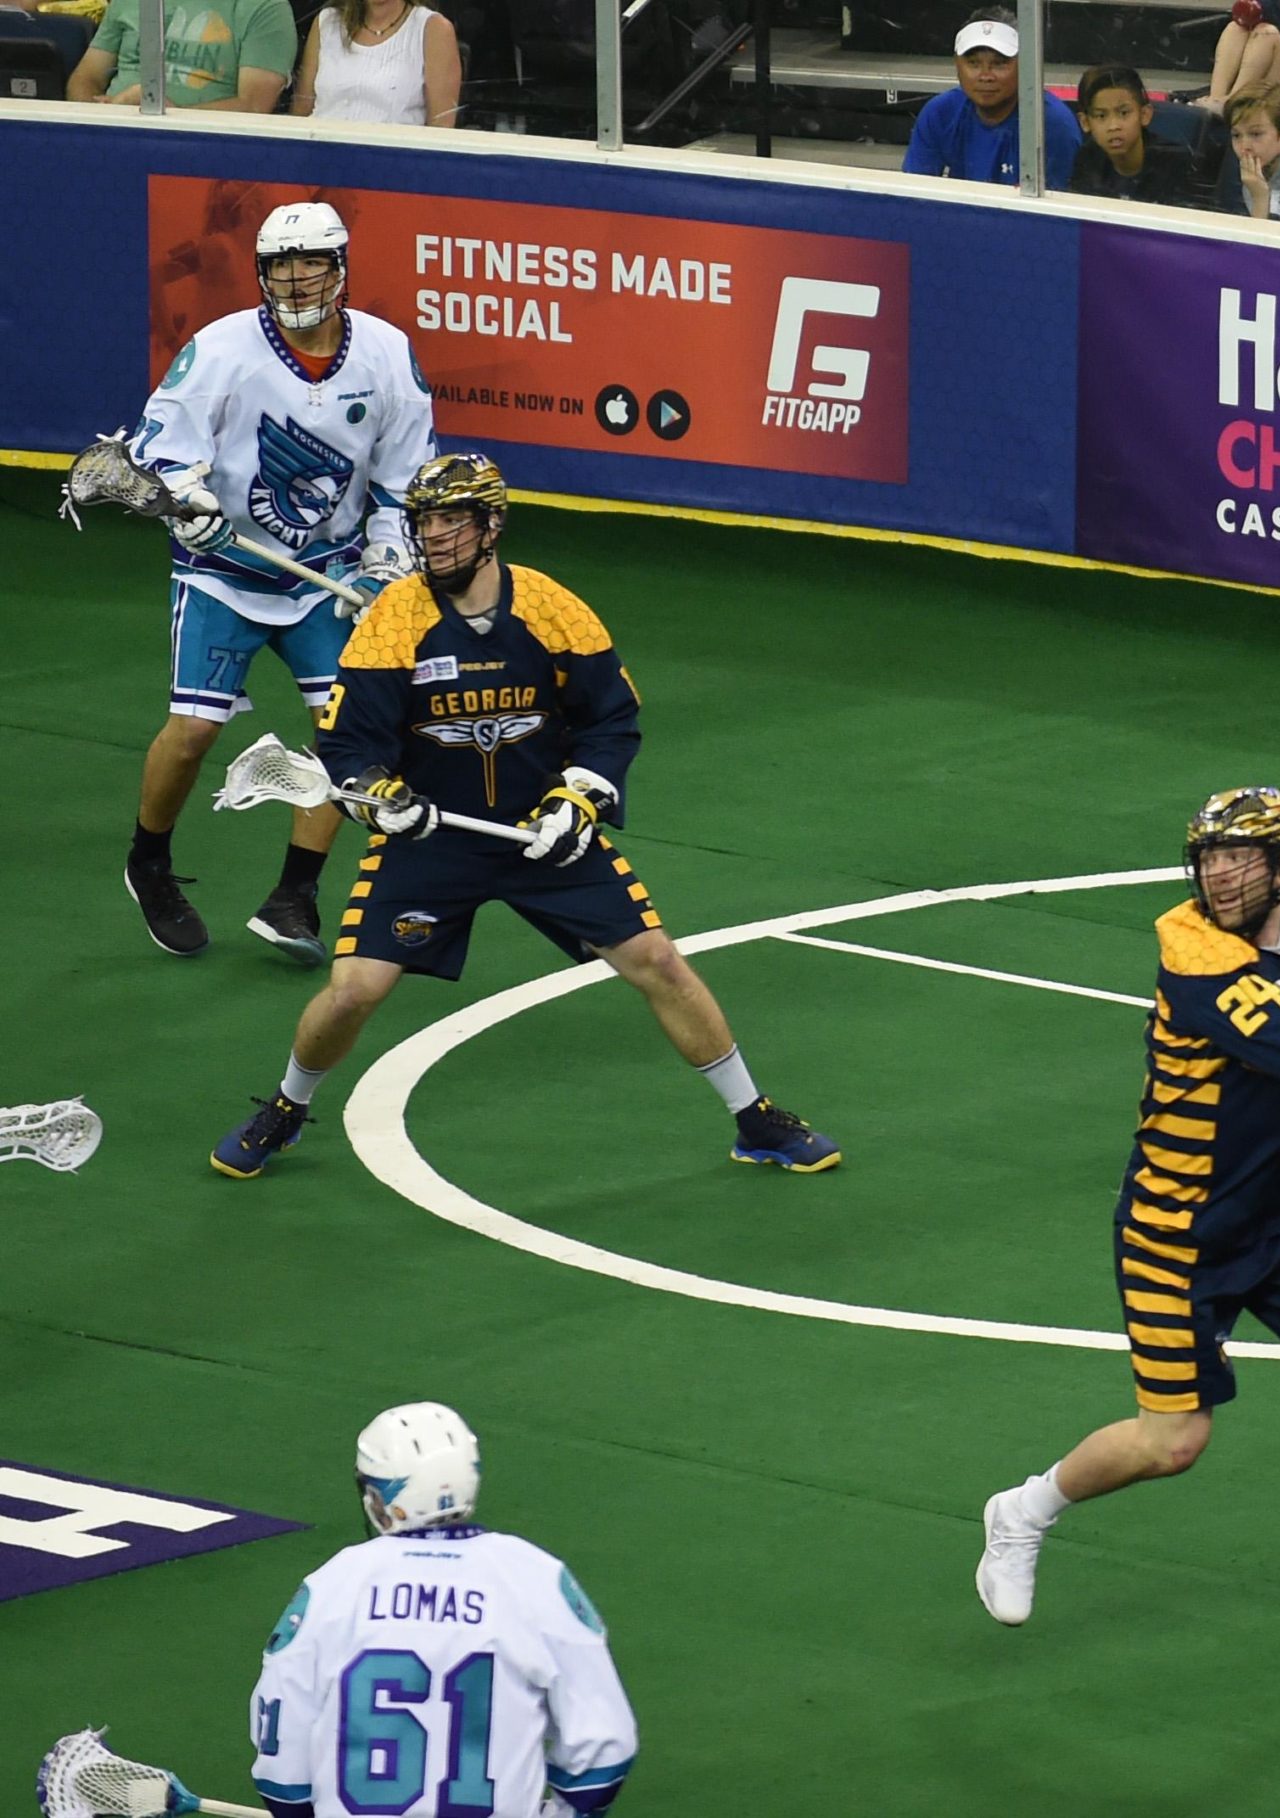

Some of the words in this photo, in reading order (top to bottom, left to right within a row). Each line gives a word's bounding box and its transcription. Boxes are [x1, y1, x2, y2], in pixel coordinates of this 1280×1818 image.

[165, 40, 222, 73] BLIN
[415, 234, 597, 290] FITNESS
[611, 252, 732, 304] MADE
[415, 289, 573, 343] SOCIAL
[513, 393, 555, 414] NOW
[559, 396, 584, 416] ON
[761, 396, 862, 434] FITGAPP
[293, 427, 346, 468] ROCHESTER
[430, 686, 537, 716] GEORGIA
[368, 1583, 485, 1625] LOMAS
[337, 1648, 495, 1818] 61
